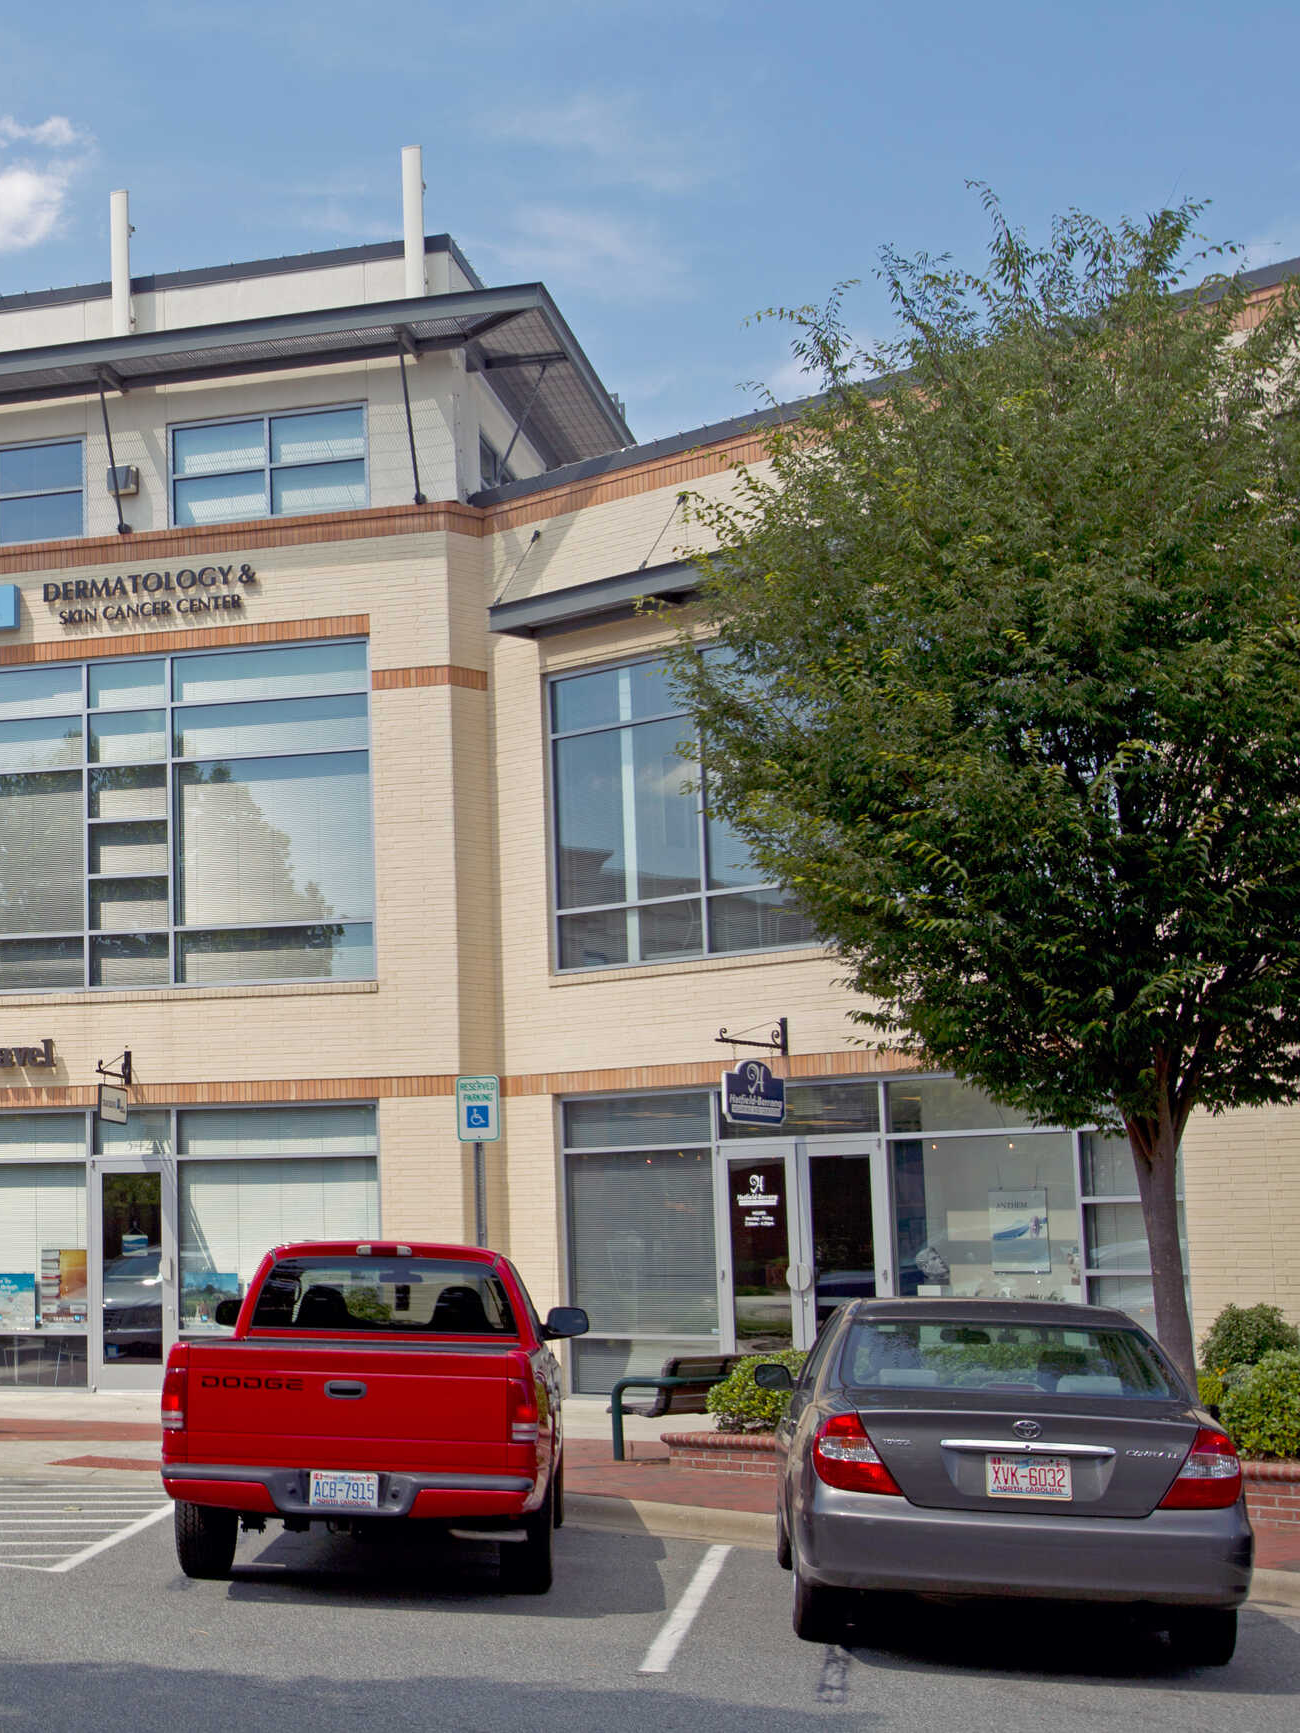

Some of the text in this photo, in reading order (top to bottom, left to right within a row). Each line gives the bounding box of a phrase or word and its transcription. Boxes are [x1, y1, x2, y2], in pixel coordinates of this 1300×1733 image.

[42, 563, 257, 603] DERMATOLOGY &
[59, 594, 243, 625] SKIN CANCER CENTER
[460, 1082, 495, 1091] RESERVED
[463, 1093, 493, 1102] PARKING
[201, 1375, 305, 1391] DODGE
[992, 1465, 1066, 1488] XVK-6032
[314, 1480, 375, 1500] ACB-7915
[996, 1485, 1062, 1494] NORTH CAROLINA
